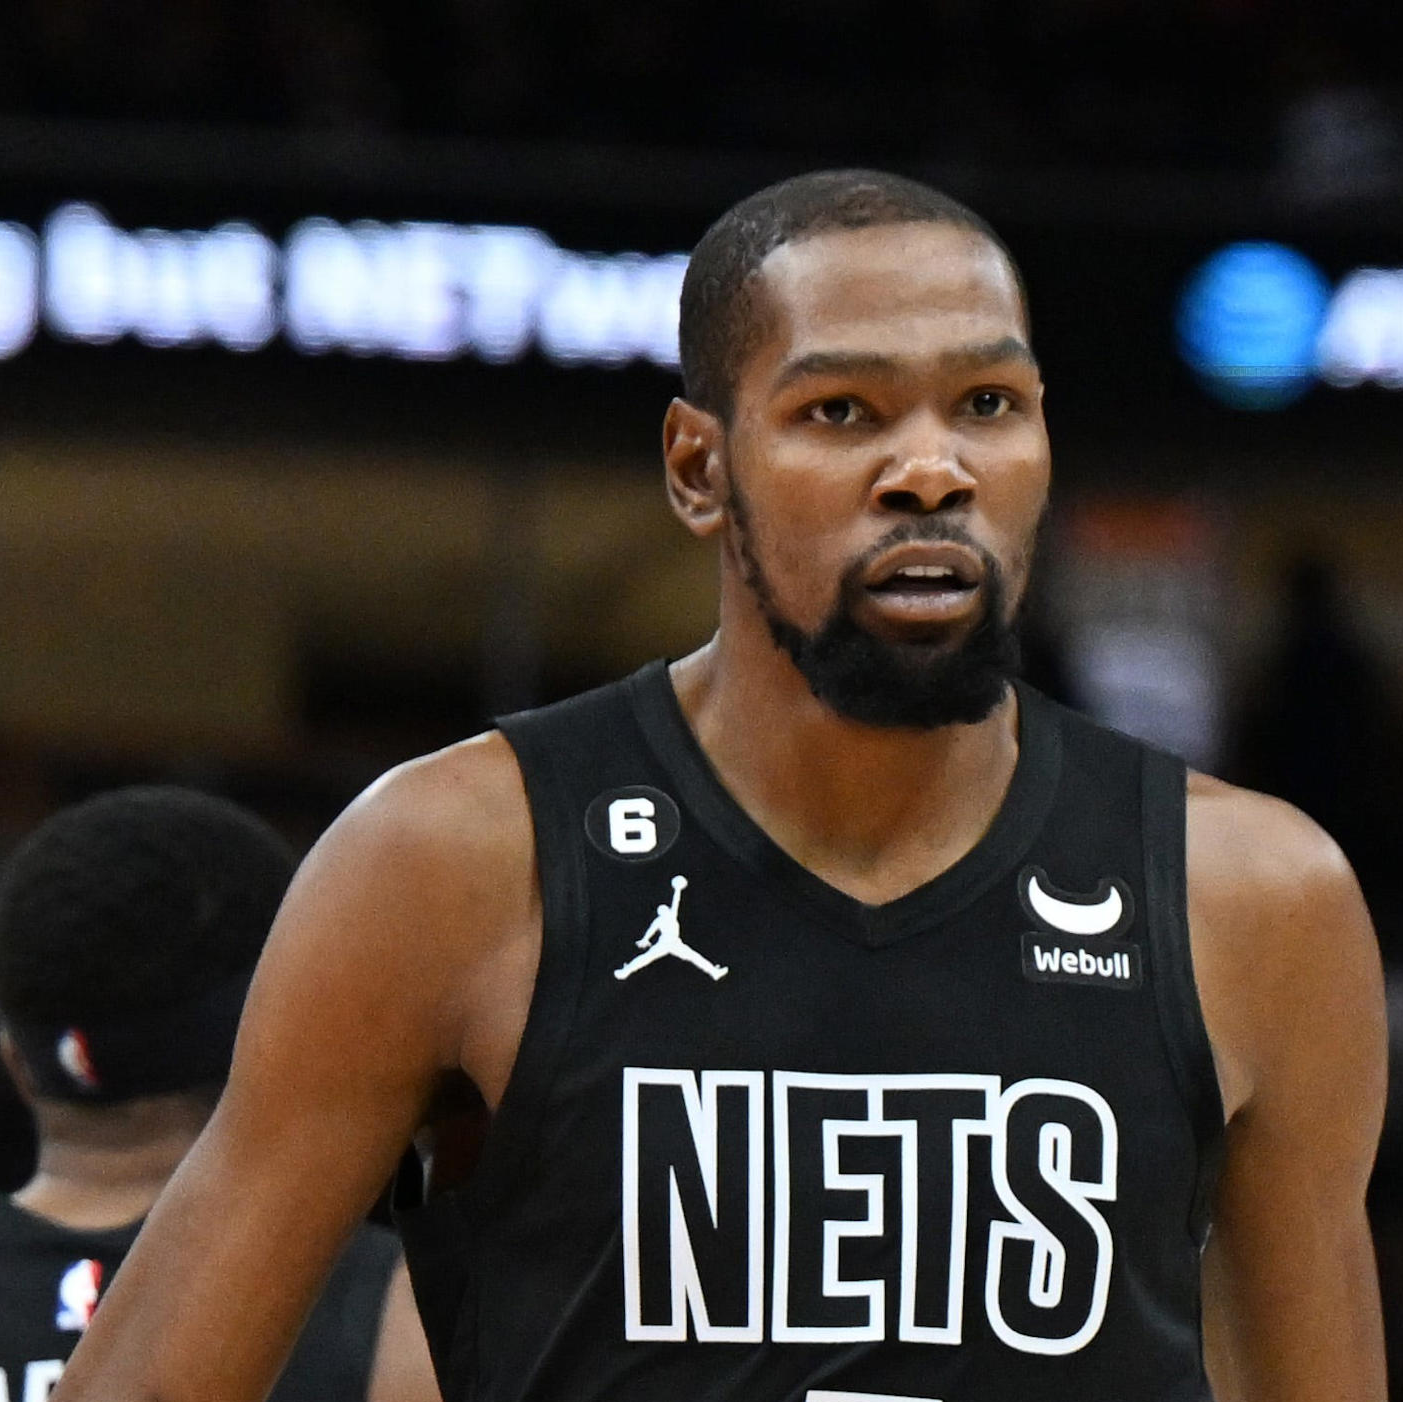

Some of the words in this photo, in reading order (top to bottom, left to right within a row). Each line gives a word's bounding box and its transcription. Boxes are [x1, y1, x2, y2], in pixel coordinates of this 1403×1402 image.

[45, 203, 277, 352] but
[608, 797, 657, 854] 6
[1034, 945, 1130, 979] Webull
[623, 1067, 1118, 1356] NETS
